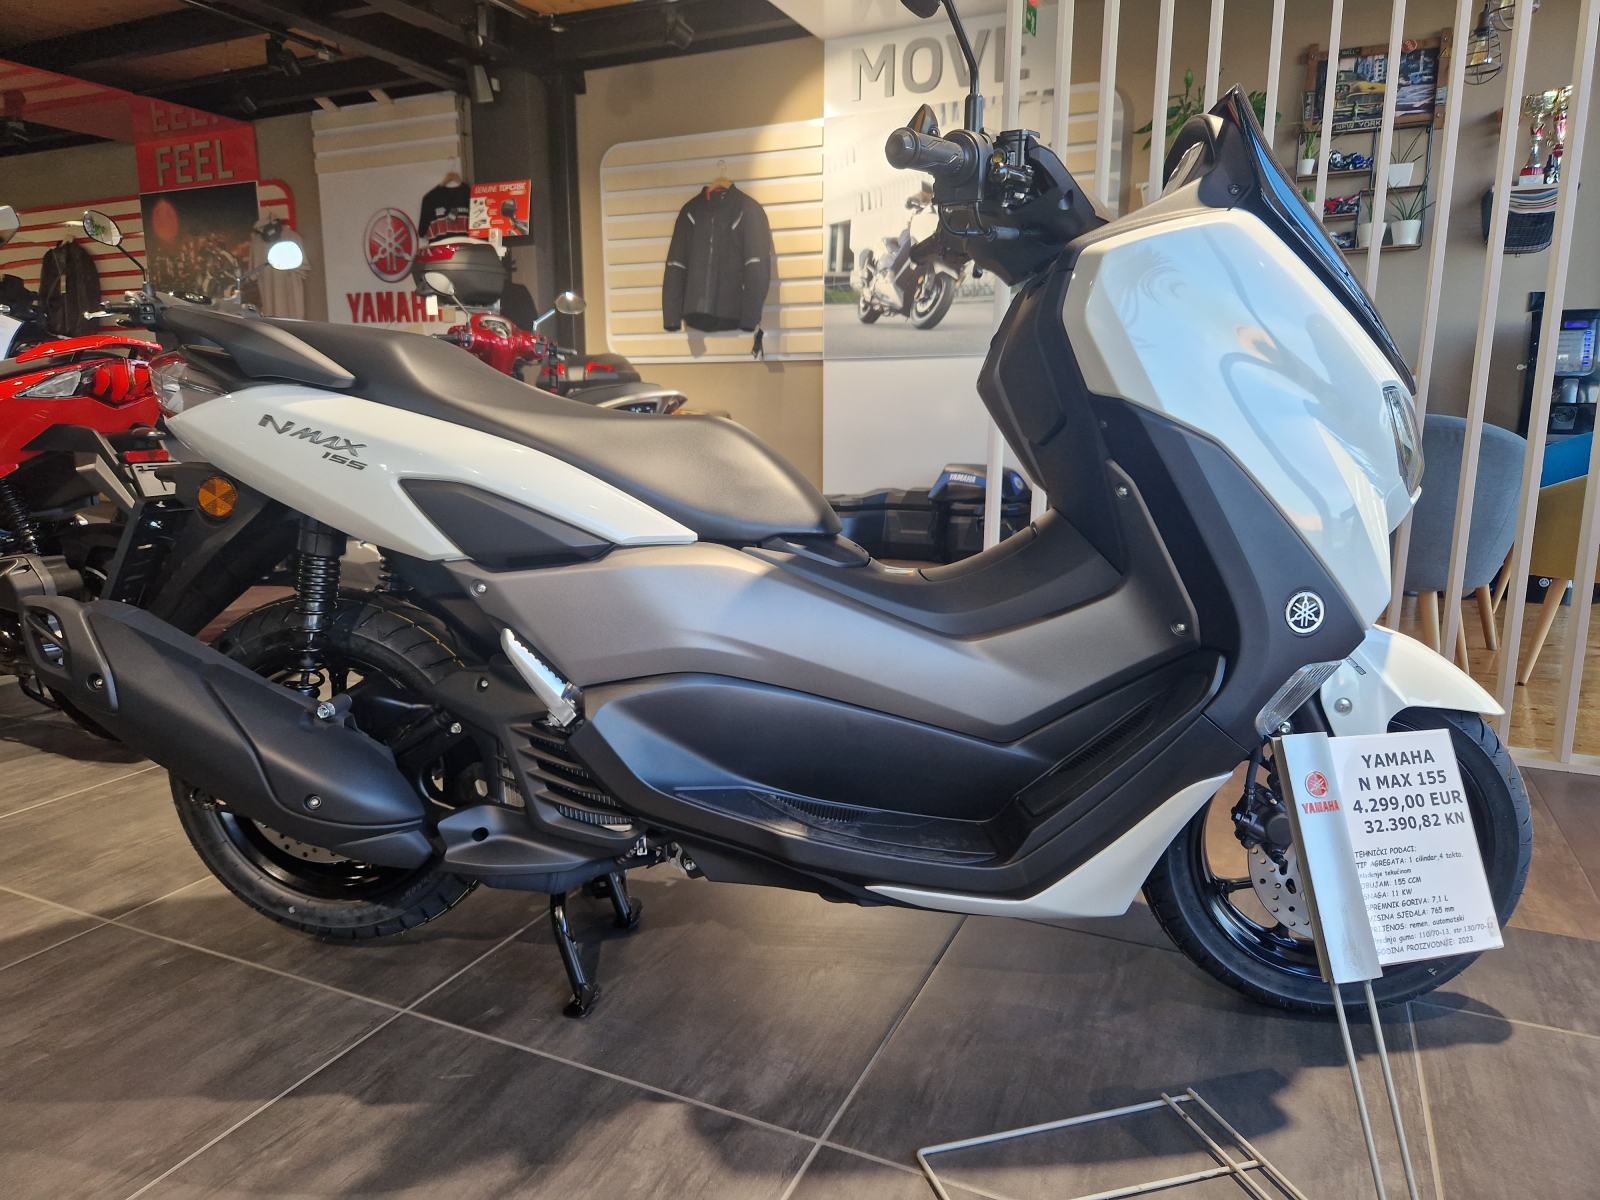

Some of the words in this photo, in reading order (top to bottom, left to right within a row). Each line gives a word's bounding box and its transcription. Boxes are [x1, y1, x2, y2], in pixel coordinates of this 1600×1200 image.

[155, 138, 234, 187] FEEL
[346, 291, 443, 324] YAMAH
[322, 451, 369, 471] 155
[949, 473, 977, 483] YAMAHA
[1361, 748, 1435, 769] YAMAHA
[1358, 776, 1371, 792] N
[1377, 773, 1412, 790] MAX
[1417, 769, 1447, 786] 155
[1301, 799, 1340, 815] YAMAHA
[1352, 793, 1426, 815] 4.299,00
[1430, 789, 1464, 806] EUR
[1364, 813, 1442, 834] 32.390,82
[1445, 811, 1465, 825] KN
[1354, 847, 1388, 859] TEHNIČKI
[1394, 878, 1406, 886] 155
[1408, 876, 1422, 884] CCM
[1391, 889, 1399, 897] 11
[1401, 888, 1413, 896] KW
[1401, 898, 1430, 908] GORIVA:
[1431, 906, 1443, 915] 765
[1458, 935, 1474, 945] 2023
